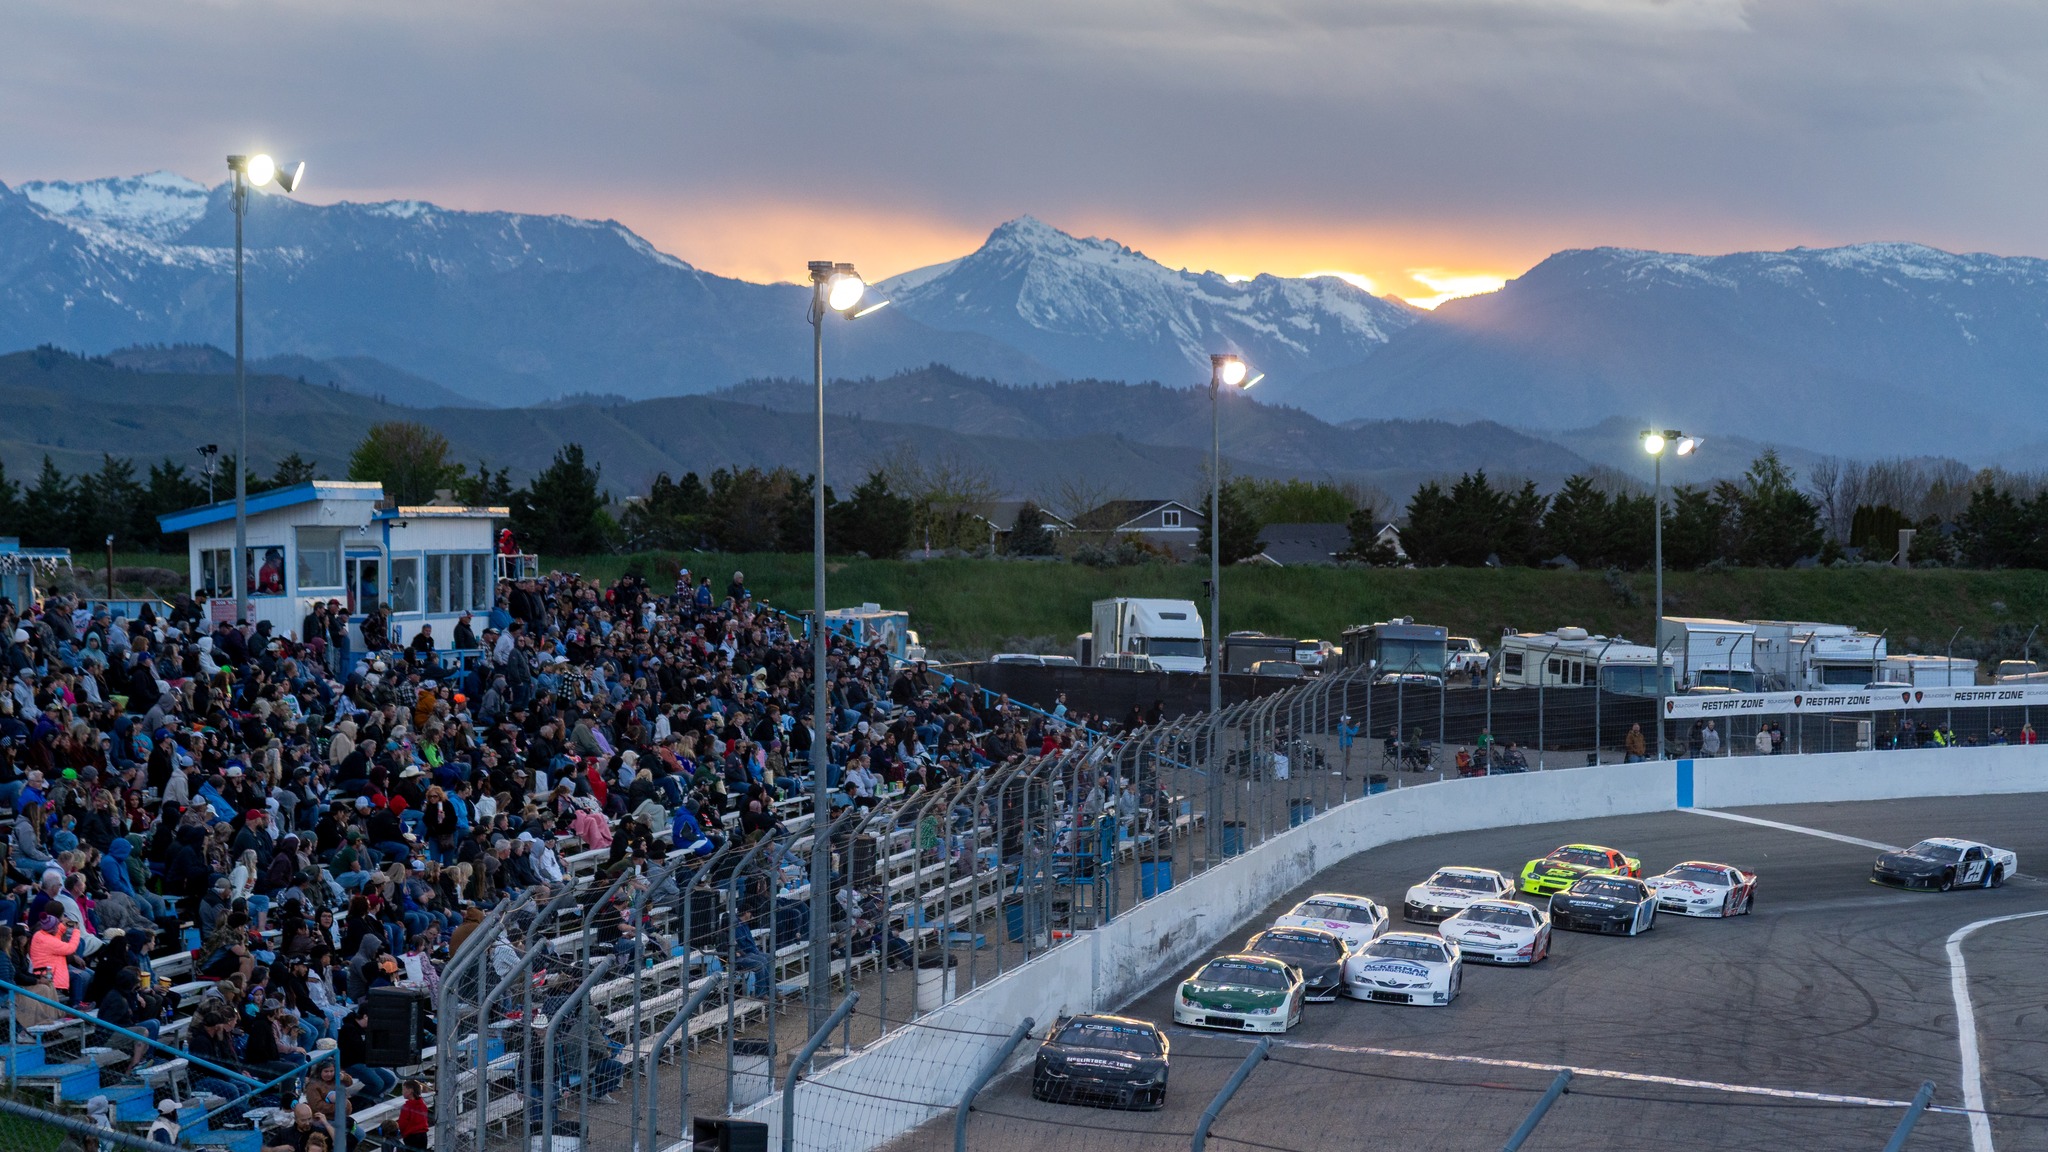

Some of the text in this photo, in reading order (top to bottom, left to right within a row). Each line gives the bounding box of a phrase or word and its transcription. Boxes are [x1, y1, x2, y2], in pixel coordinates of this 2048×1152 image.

[1806, 695, 1870, 706] RESTART ZONE
[1954, 690, 2024, 701] RESTART ZONE
[1701, 698, 1764, 711] RESTART ZONE
[1363, 968, 1414, 976] CONSTRUCTION
[1364, 964, 1429, 975] ACKERMAN
